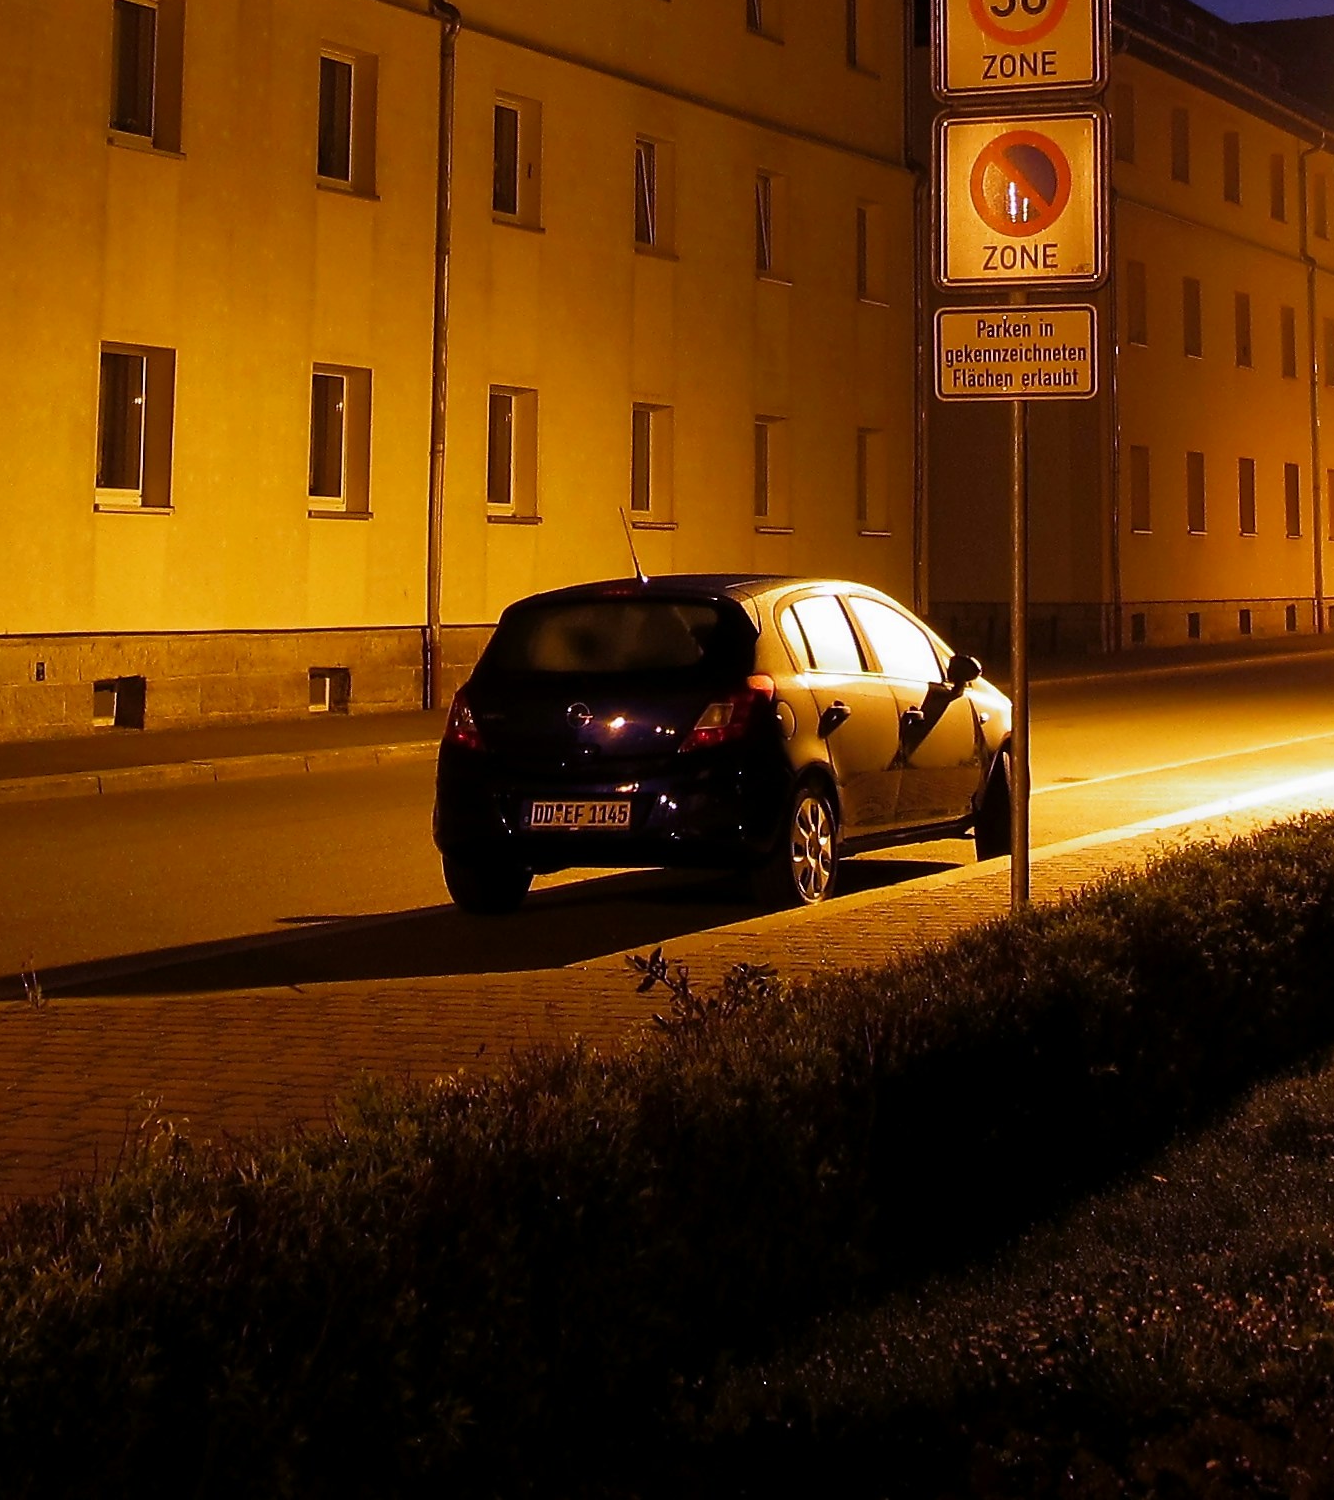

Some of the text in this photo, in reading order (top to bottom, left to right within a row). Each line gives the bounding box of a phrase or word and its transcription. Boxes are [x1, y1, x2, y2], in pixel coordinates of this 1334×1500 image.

[982, 50, 1058, 80] ZONE
[982, 243, 1059, 271] ZONE
[976, 318, 1054, 339] Parken in
[945, 343, 1087, 368] gekennzeichneten
[952, 367, 1079, 388] Flächen erlaubt
[587, 804, 628, 824] 1145
